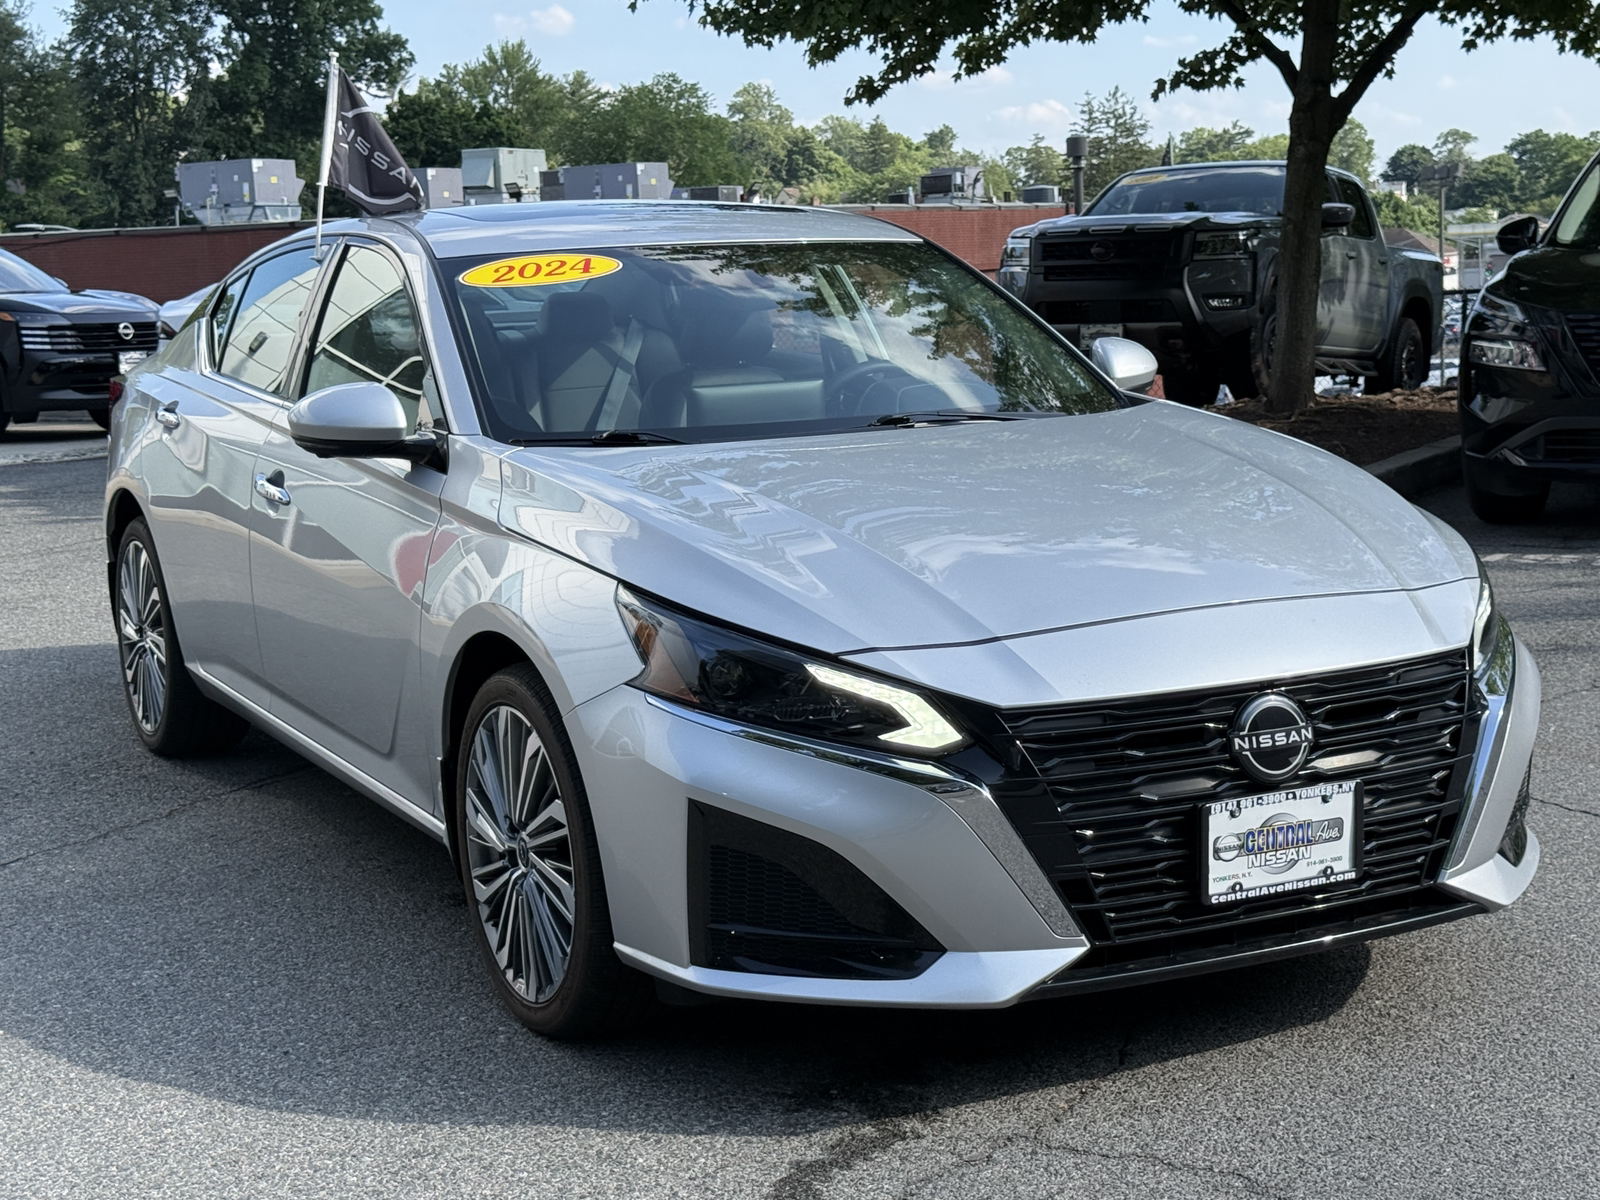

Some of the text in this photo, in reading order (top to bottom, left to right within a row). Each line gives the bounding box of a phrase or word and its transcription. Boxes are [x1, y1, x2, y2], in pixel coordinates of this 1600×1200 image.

[491, 257, 596, 284] 2024
[1233, 726, 1313, 750] NISSAN
[1215, 843, 1242, 852] NISSAN
[1244, 819, 1341, 854] CENTRAL Ave.
[1247, 844, 1312, 869] NISSAN
[1210, 871, 1356, 904] CentralAveNissan.com
